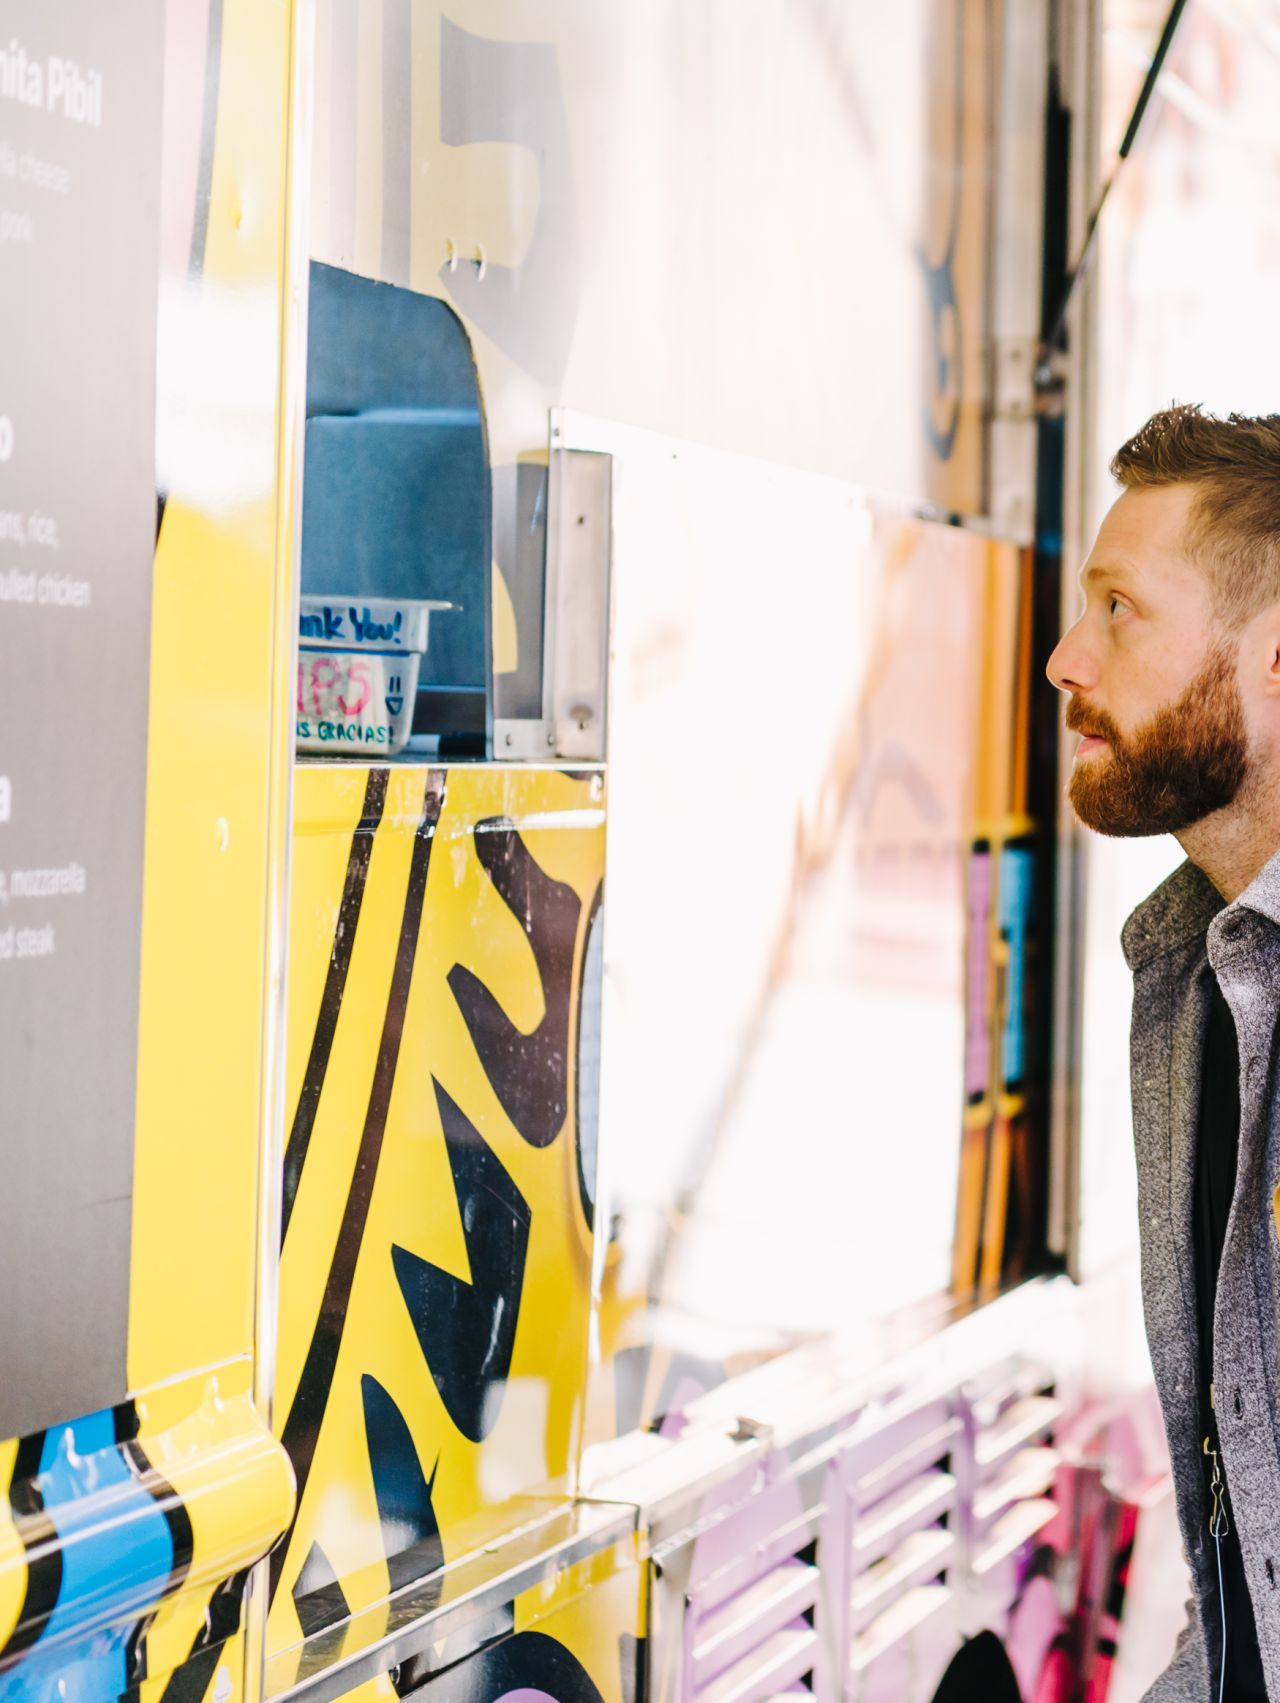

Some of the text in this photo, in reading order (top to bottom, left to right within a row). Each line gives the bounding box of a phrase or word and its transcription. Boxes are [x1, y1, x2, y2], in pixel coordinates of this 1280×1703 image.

[47, 54, 102, 128] Pibil
[38, 571, 91, 607] chicken
[348, 606, 402, 644] You!
[317, 720, 394, 745] GRACIAS!
